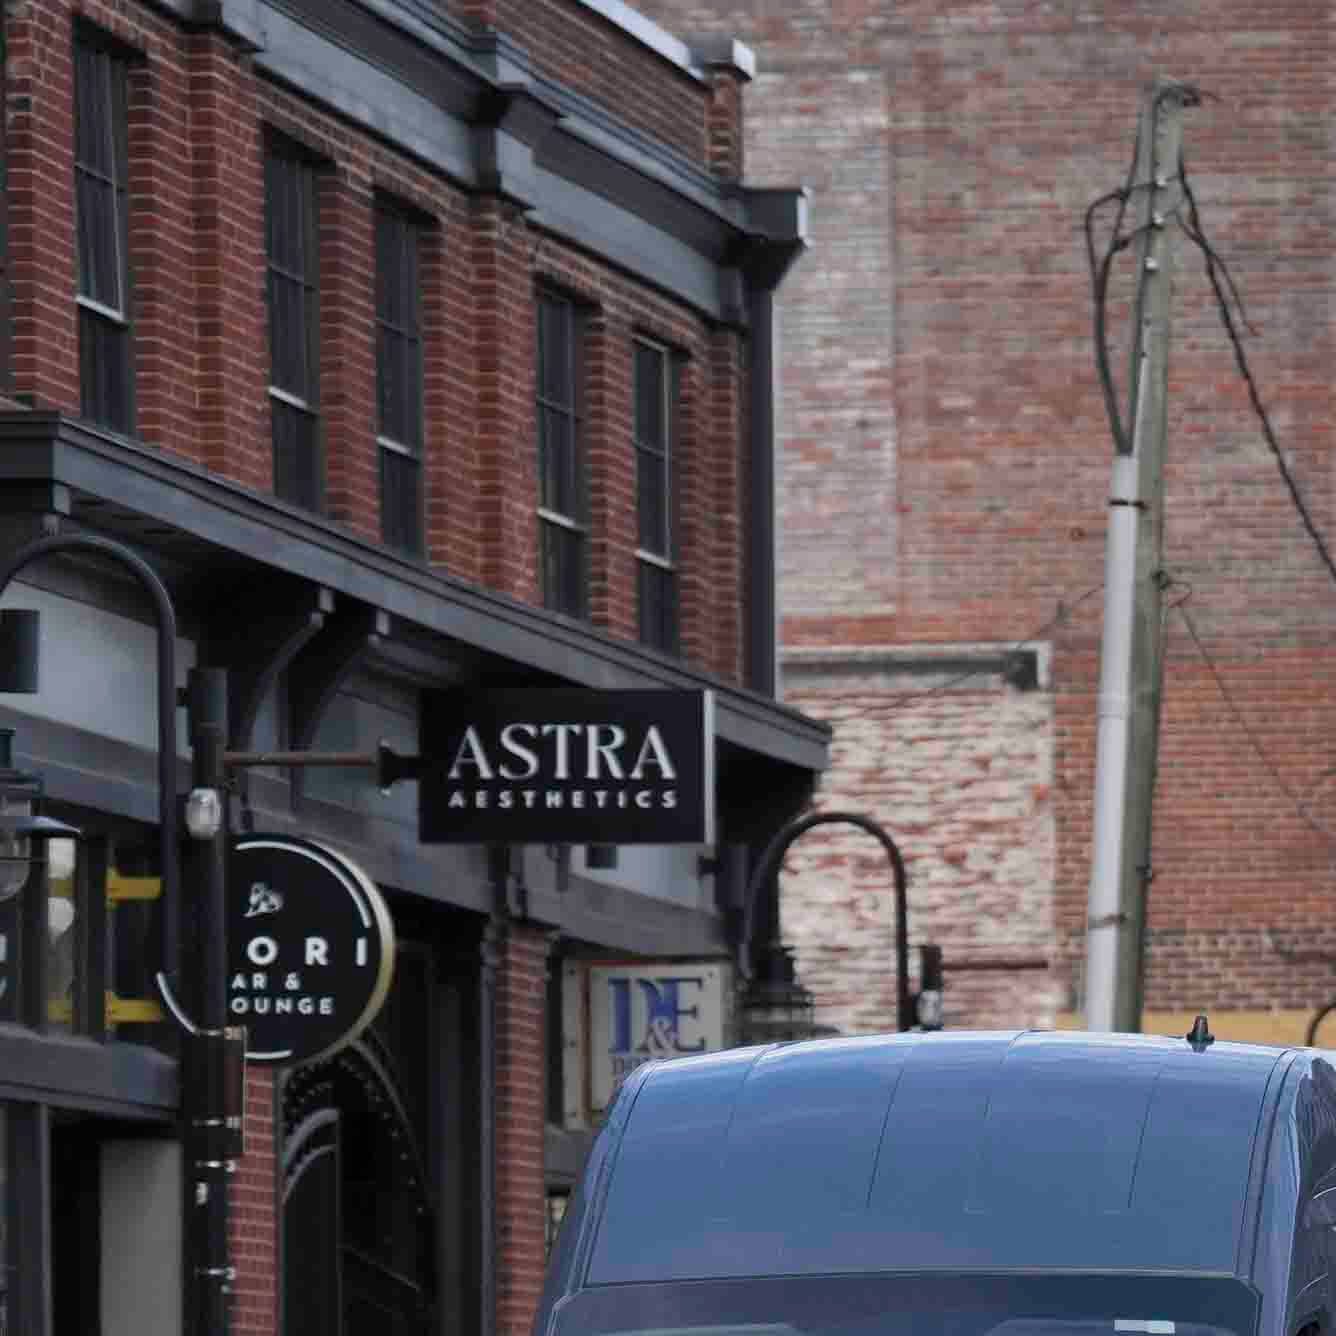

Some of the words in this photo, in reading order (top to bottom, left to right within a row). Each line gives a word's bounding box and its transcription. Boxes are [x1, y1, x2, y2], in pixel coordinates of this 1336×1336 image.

[447, 723, 677, 780] ASTRA
[447, 789, 677, 808] AESTHETICS
[246, 936, 368, 966] ORI
[231, 973, 266, 990] AR
[231, 997, 333, 1015] OUNGE
